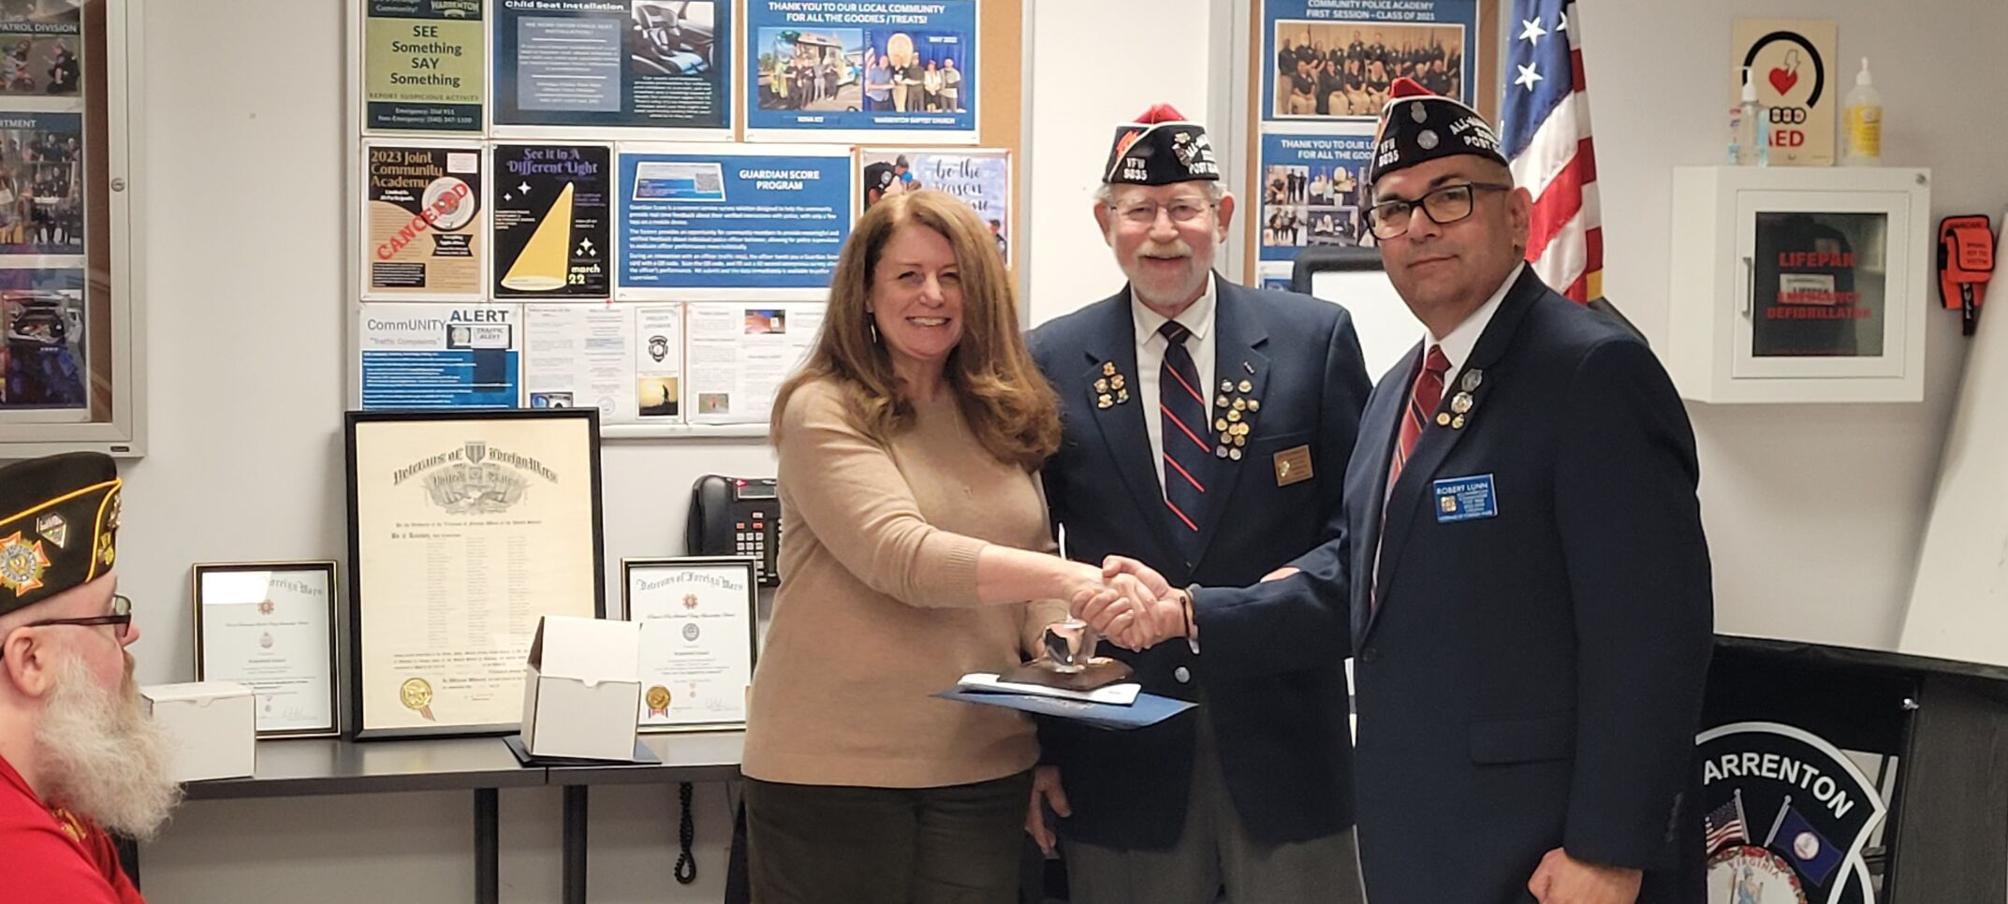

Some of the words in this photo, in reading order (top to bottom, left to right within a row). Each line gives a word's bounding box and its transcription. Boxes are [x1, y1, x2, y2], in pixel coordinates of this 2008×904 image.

[504, 1, 535, 9] Child
[563, 2, 625, 10] Installation
[768, 2, 800, 11] THANK
[800, 3, 822, 11] YOU
[822, 3, 836, 11] TO
[837, 4, 857, 12] OUR
[859, 4, 887, 12] LOCAL
[888, 5, 945, 13] COMMUNITY
[1308, 0, 1360, 8] COMMUNITY
[1362, 0, 1391, 9] POLICE
[1392, 1, 1434, 10] ACADEMY
[786, 13, 805, 22] FOR
[806, 14, 824, 22] ALL
[824, 14, 843, 22] THE
[844, 14, 885, 23] GOODIES
[1306, 9, 1330, 18] FIRST
[1333, 10, 1370, 19] SESSION
[1376, 11, 1401, 20] CLASS
[1403, 12, 1415, 20] OF
[34, 24, 77, 32] DIVISION
[413, 25, 438, 38] SEE
[392, 41, 462, 56] Something
[411, 58, 440, 69] SAY
[390, 73, 461, 88] Something
[1281, 139, 1312, 149] THANK
[1312, 140, 1332, 149] YOU
[1332, 140, 1345, 149] TO
[1345, 141, 1365, 149] OUR
[371, 151, 401, 163] 2023
[404, 151, 433, 165] Joint
[523, 148, 544, 160] See
[569, 148, 580, 160] A
[1297, 150, 1316, 160] FOR
[1317, 150, 1334, 160] ALL
[1334, 151, 1351, 160] THE
[506, 160, 562, 175] Different
[564, 161, 598, 176] Light
[936, 159, 954, 179] be
[959, 158, 981, 179] the
[1126, 157, 1146, 169] VFW
[371, 164, 443, 178] Community
[739, 169, 788, 179] GUARDIAN
[789, 170, 820, 180] SCORE
[371, 176, 430, 188] Academy
[756, 181, 803, 190] PROGRAM
[571, 264, 601, 273] march
[568, 274, 586, 285] 22
[450, 310, 509, 322] ALERT
[367, 319, 447, 331] CommUNITY
[1436, 484, 1465, 495] ROBERT
[1704, 752, 1855, 820] ARRENTON
